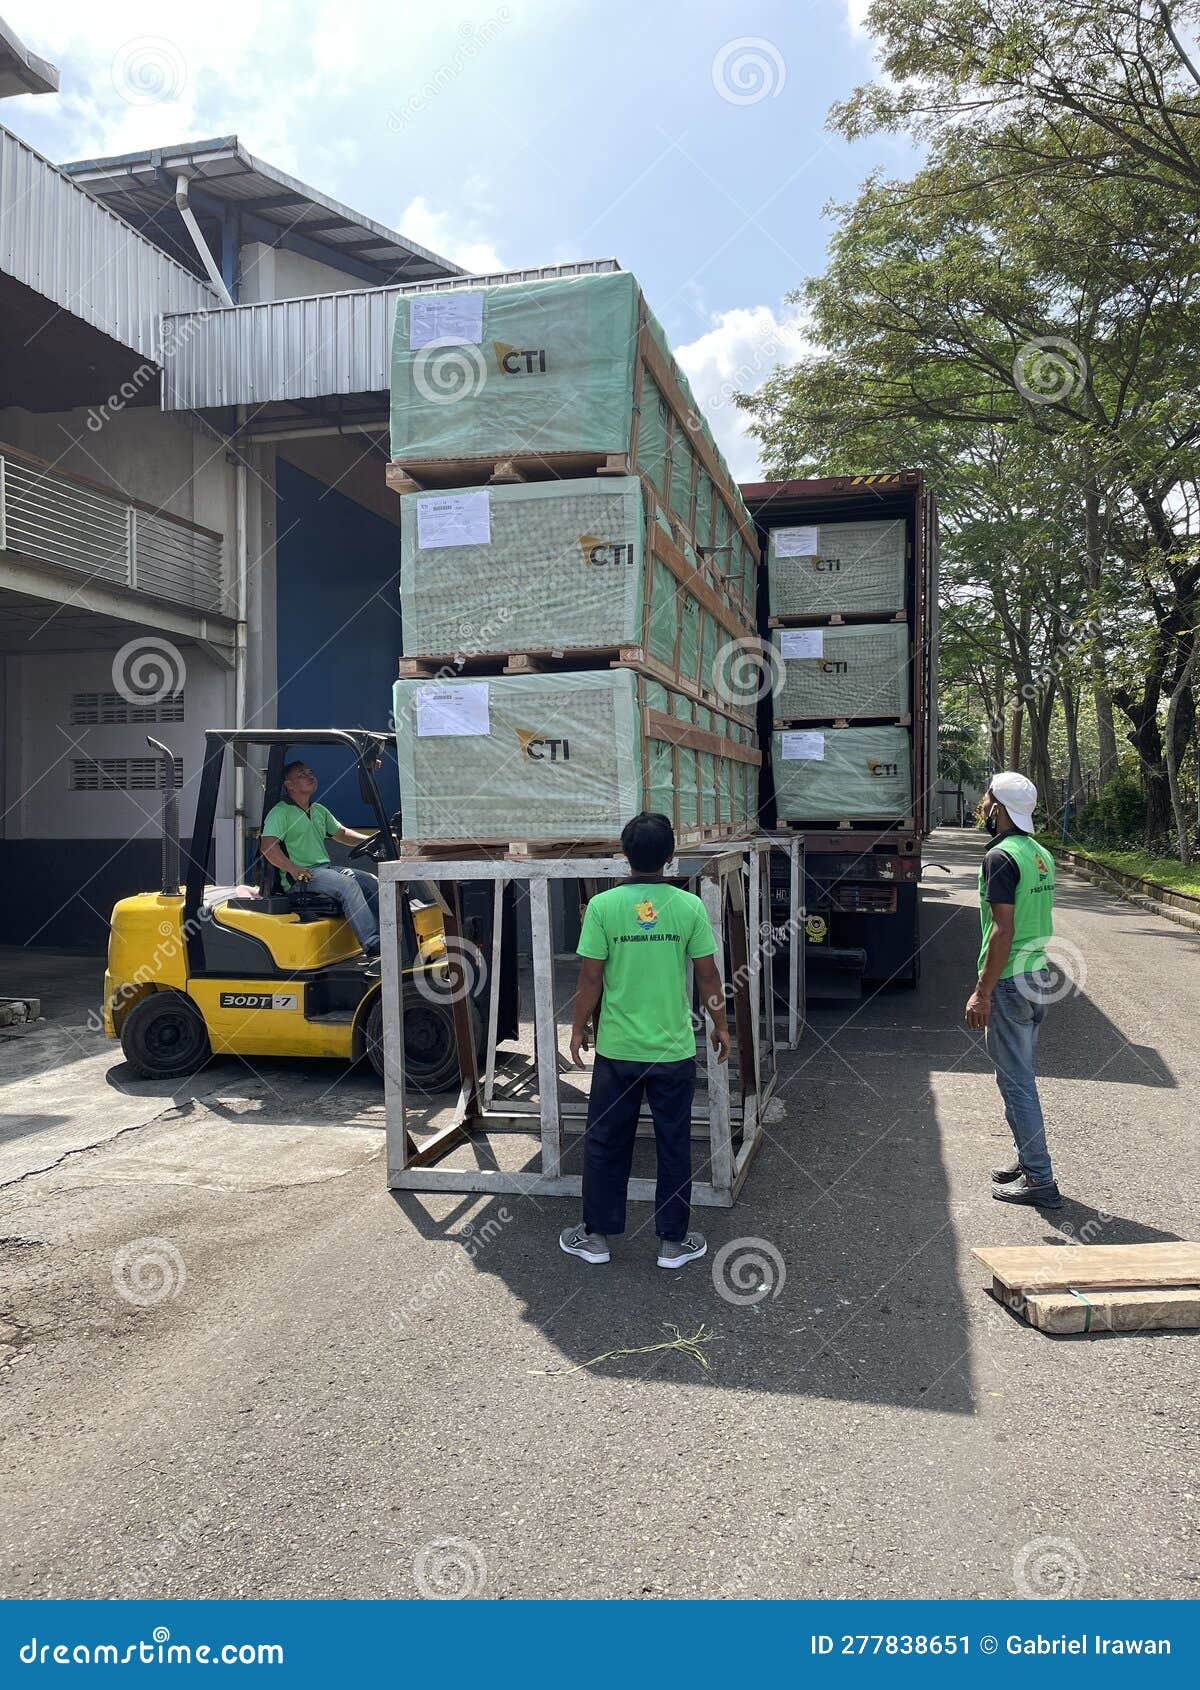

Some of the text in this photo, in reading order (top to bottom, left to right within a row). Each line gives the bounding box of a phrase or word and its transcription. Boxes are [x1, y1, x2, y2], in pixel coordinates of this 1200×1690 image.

[502, 350, 546, 374] CTI
[590, 544, 633, 566] CTI
[816, 559, 840, 571] CTI
[823, 661, 848, 673] CTI
[527, 739, 570, 760] CTI
[872, 763, 897, 776] CTI
[223, 995, 270, 1007] 30DT
